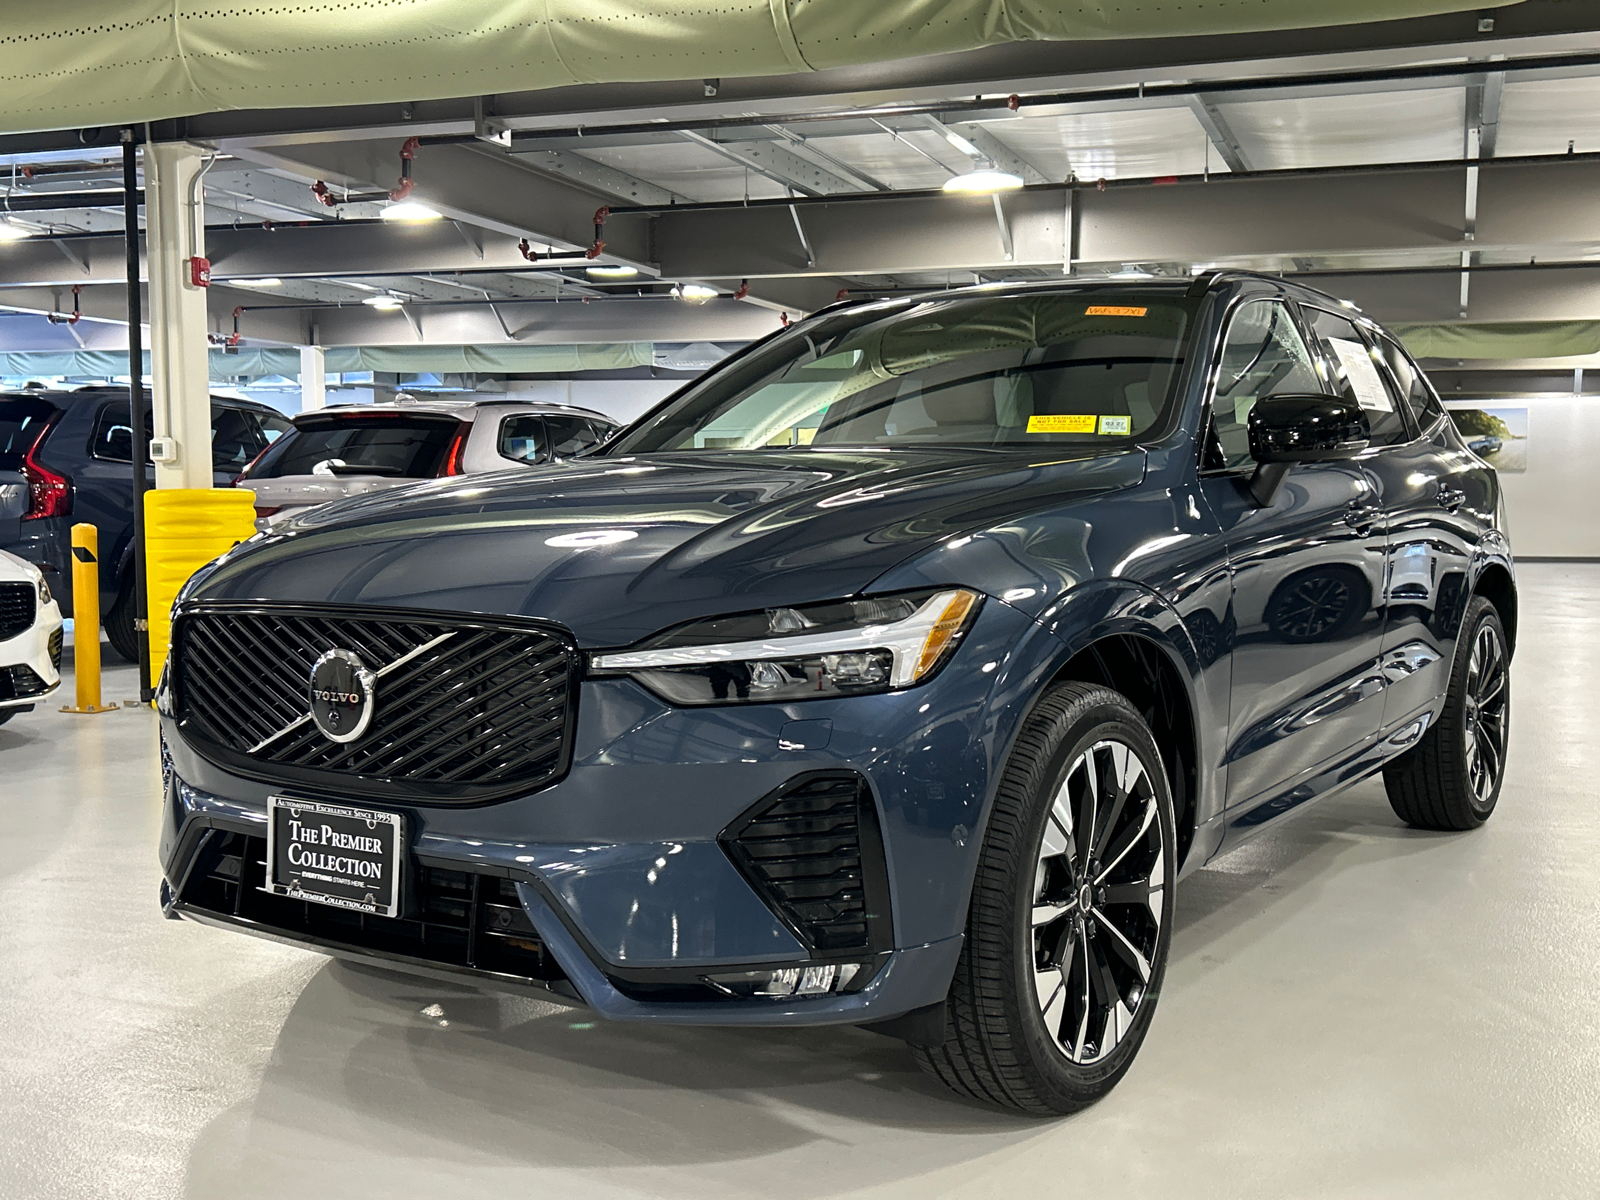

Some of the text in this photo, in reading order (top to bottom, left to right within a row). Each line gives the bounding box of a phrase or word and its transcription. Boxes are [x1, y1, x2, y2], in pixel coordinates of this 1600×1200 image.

[313, 689, 359, 703] VOLVO
[374, 812, 391, 823] 1995
[288, 820, 383, 854] THE PREMIER
[288, 843, 383, 879] COLLECTION
[301, 871, 333, 882] EVERYTHING
[332, 877, 351, 886] STARTS
